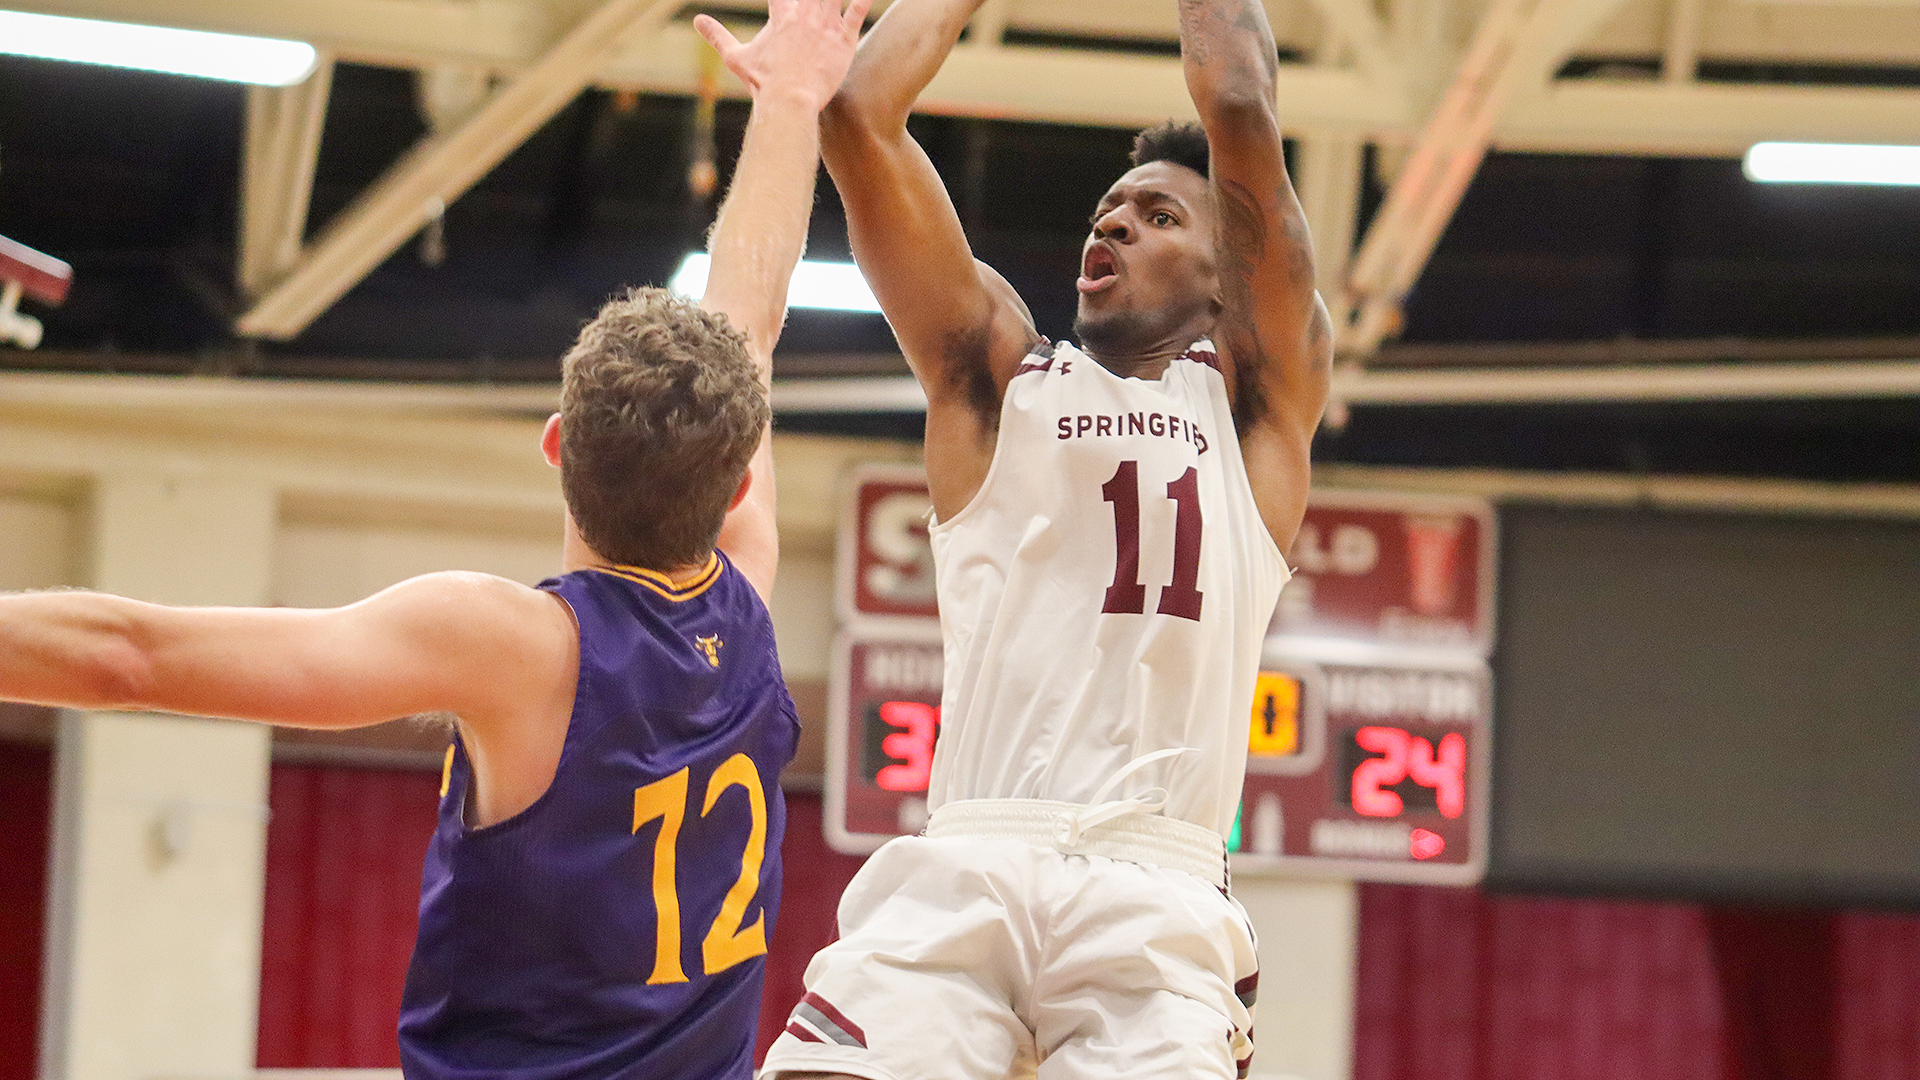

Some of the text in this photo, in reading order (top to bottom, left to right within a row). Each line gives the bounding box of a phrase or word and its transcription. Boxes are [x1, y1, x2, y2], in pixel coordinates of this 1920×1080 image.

[1057, 412, 1209, 456] SPRINGFIED
[1101, 460, 1203, 622] 11
[876, 700, 941, 791] 3
[1351, 726, 1466, 819] 24
[632, 753, 768, 985] 12
